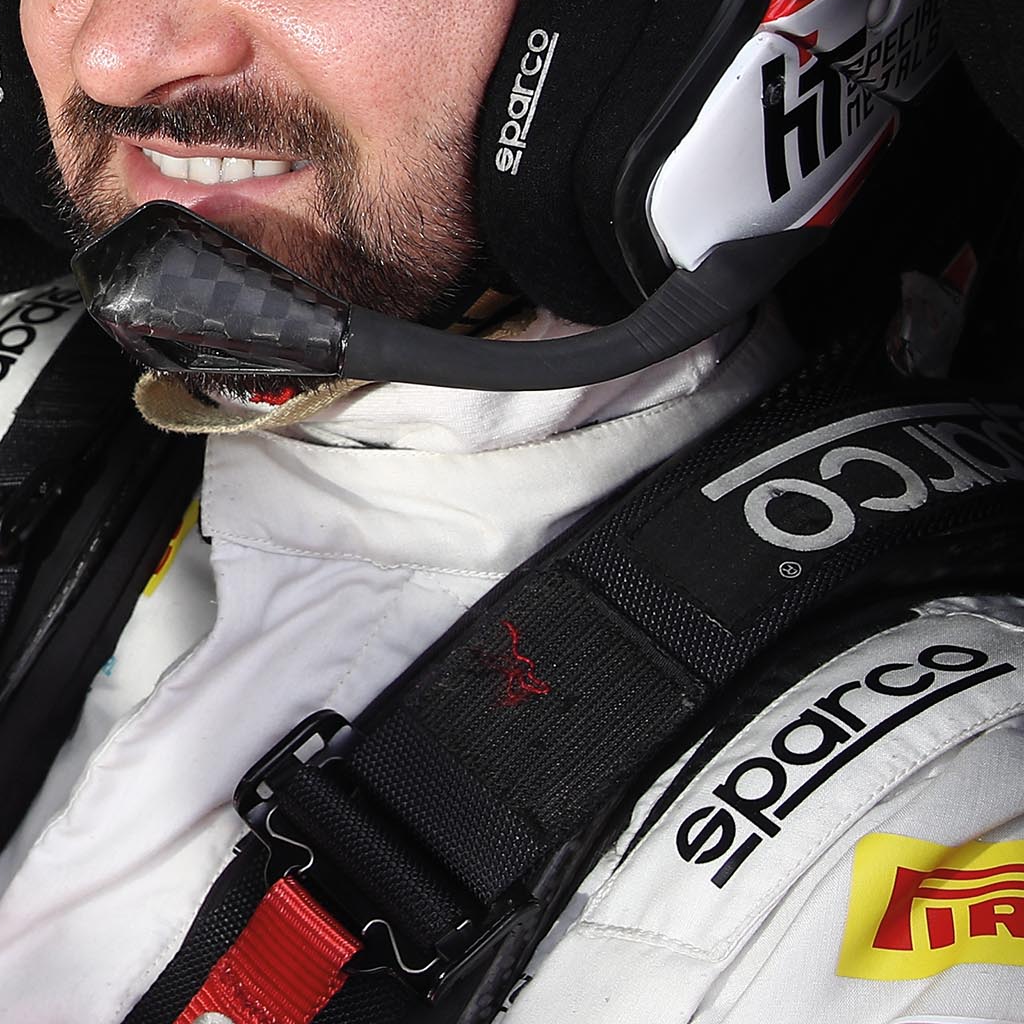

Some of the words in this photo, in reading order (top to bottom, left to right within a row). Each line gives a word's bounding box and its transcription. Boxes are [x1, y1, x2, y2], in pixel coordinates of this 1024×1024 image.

[495, 29, 559, 175] sparco
[742, 403, 1024, 553] arco
[676, 644, 996, 871] sparco
